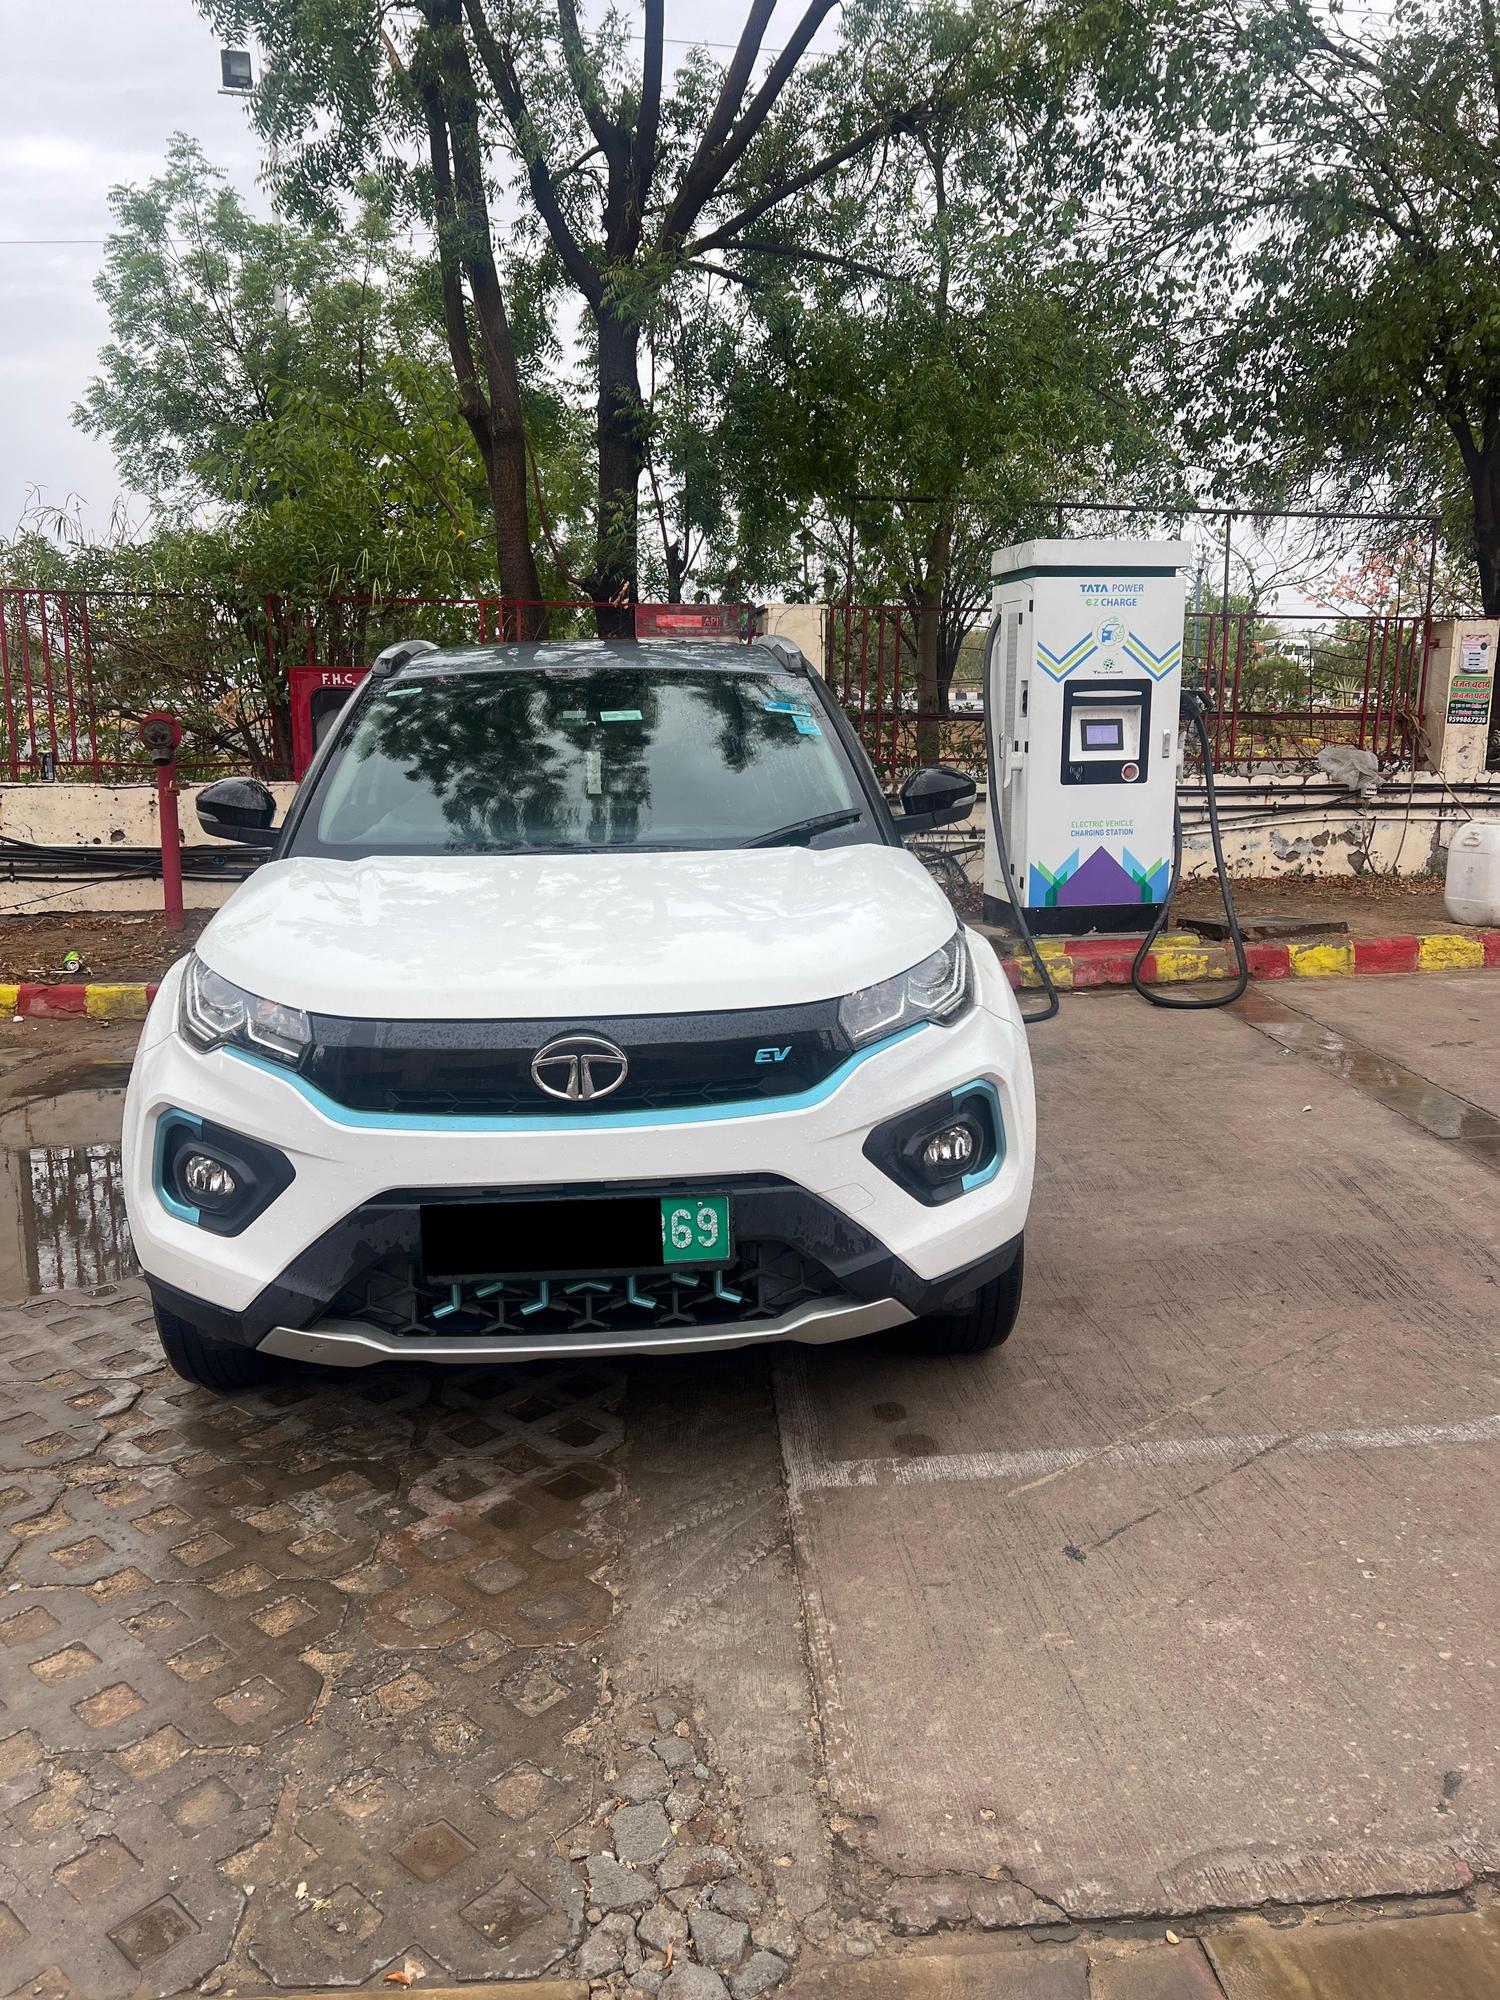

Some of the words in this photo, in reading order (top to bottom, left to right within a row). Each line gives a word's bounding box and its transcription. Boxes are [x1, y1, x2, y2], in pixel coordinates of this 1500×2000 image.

[1080, 584, 1108, 593] TATA
[1112, 584, 1144, 593] POWER
[1101, 598, 1137, 607] CHARGE
[321, 673, 356, 686] F.H.C.
[1071, 820, 1103, 828] ELECTRIC
[1105, 819, 1134, 827] VEHICLE
[1070, 829, 1104, 837] CHARGING
[1105, 828, 1133, 836] STATION
[755, 1046, 792, 1062] EV
[661, 1207, 719, 1249] 69
